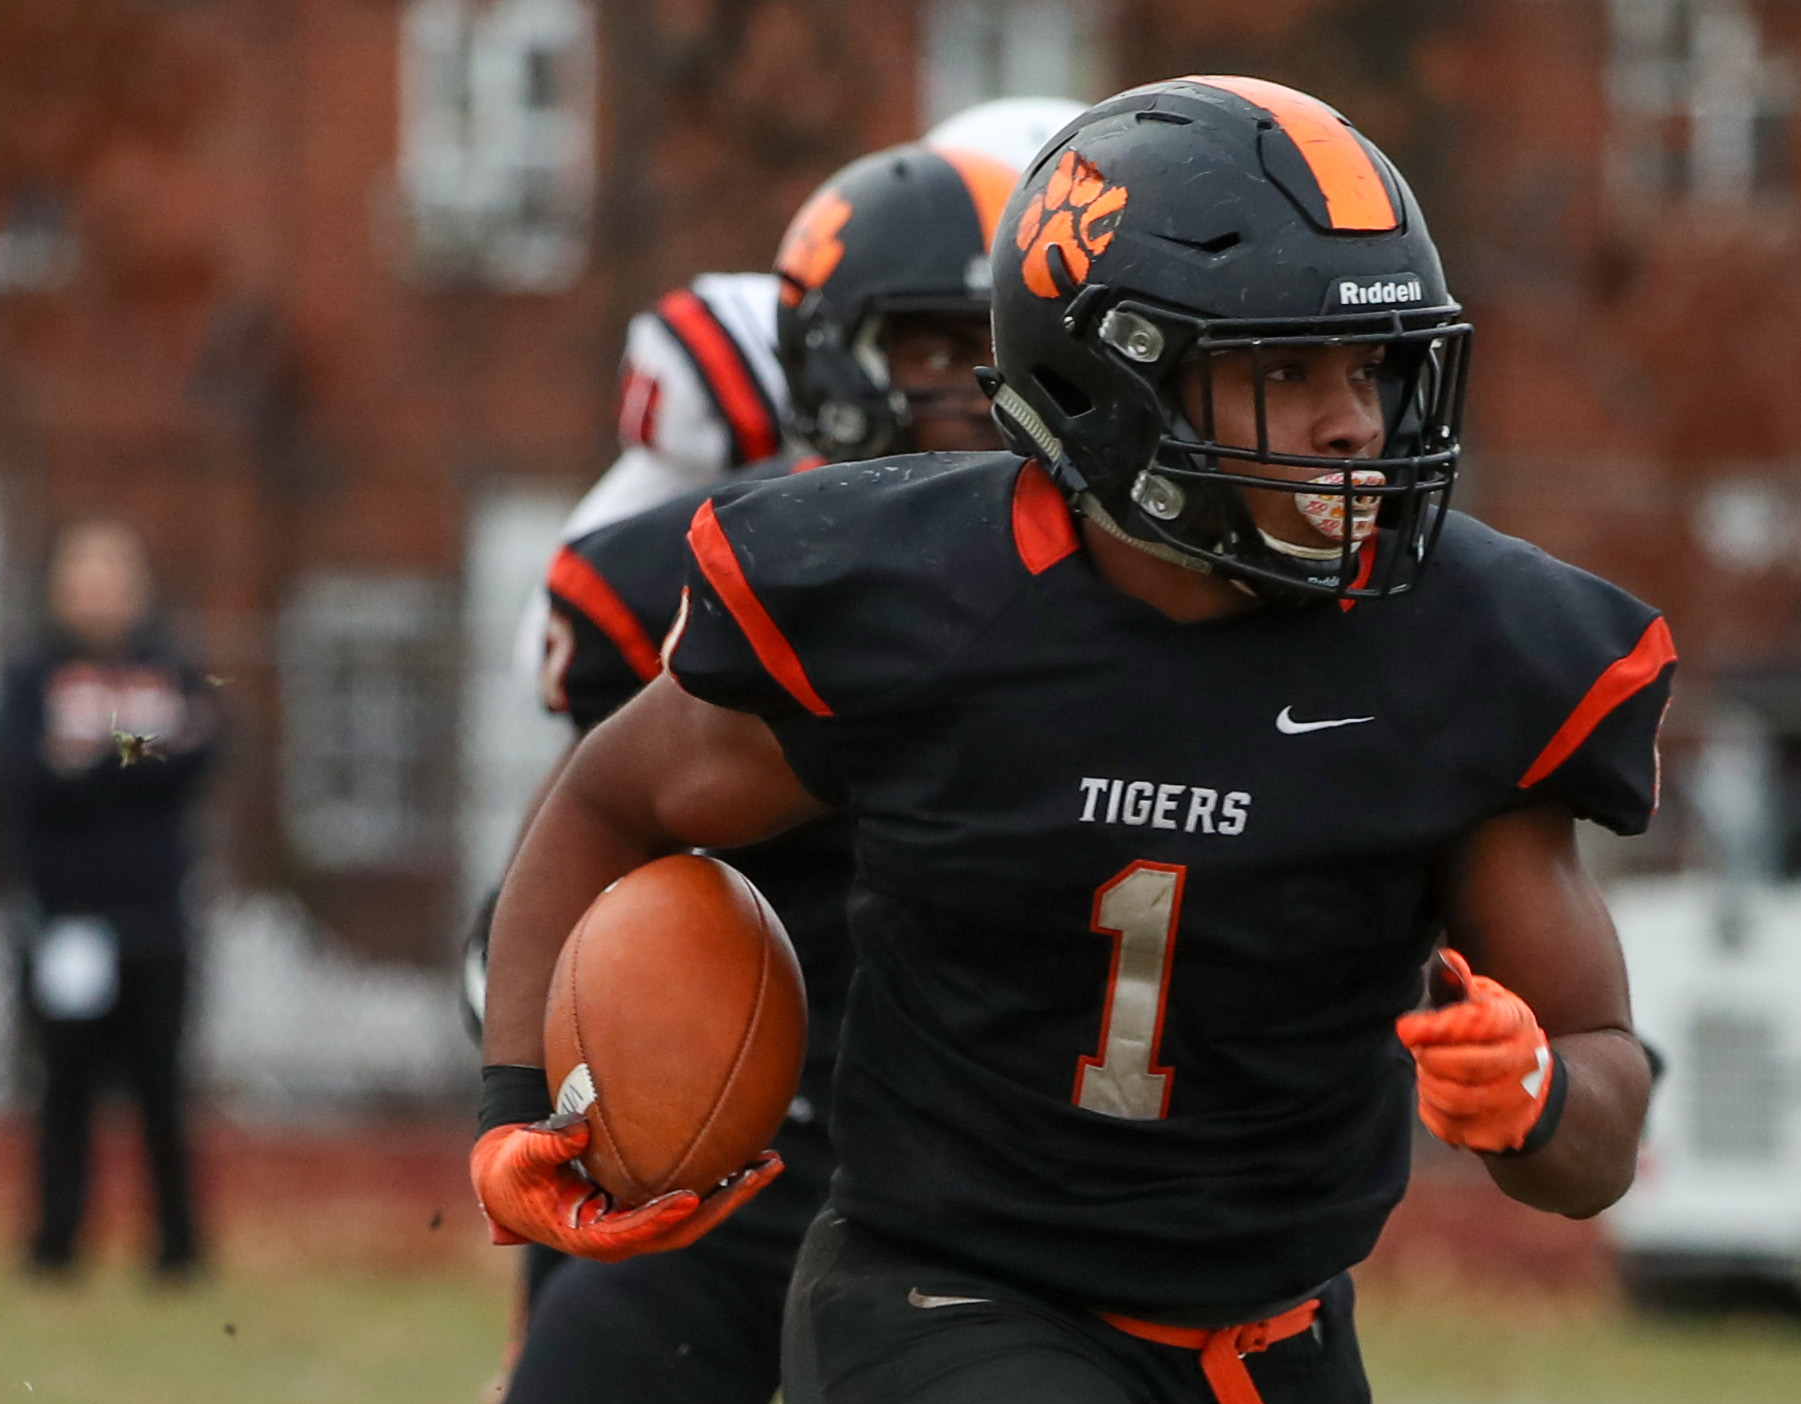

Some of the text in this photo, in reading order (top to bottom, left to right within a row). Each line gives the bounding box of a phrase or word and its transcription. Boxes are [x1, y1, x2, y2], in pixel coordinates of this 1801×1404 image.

[1339, 281, 1422, 304] Riddell
[1079, 777, 1252, 836] TIGERS
[1072, 859, 1187, 1120] 1
